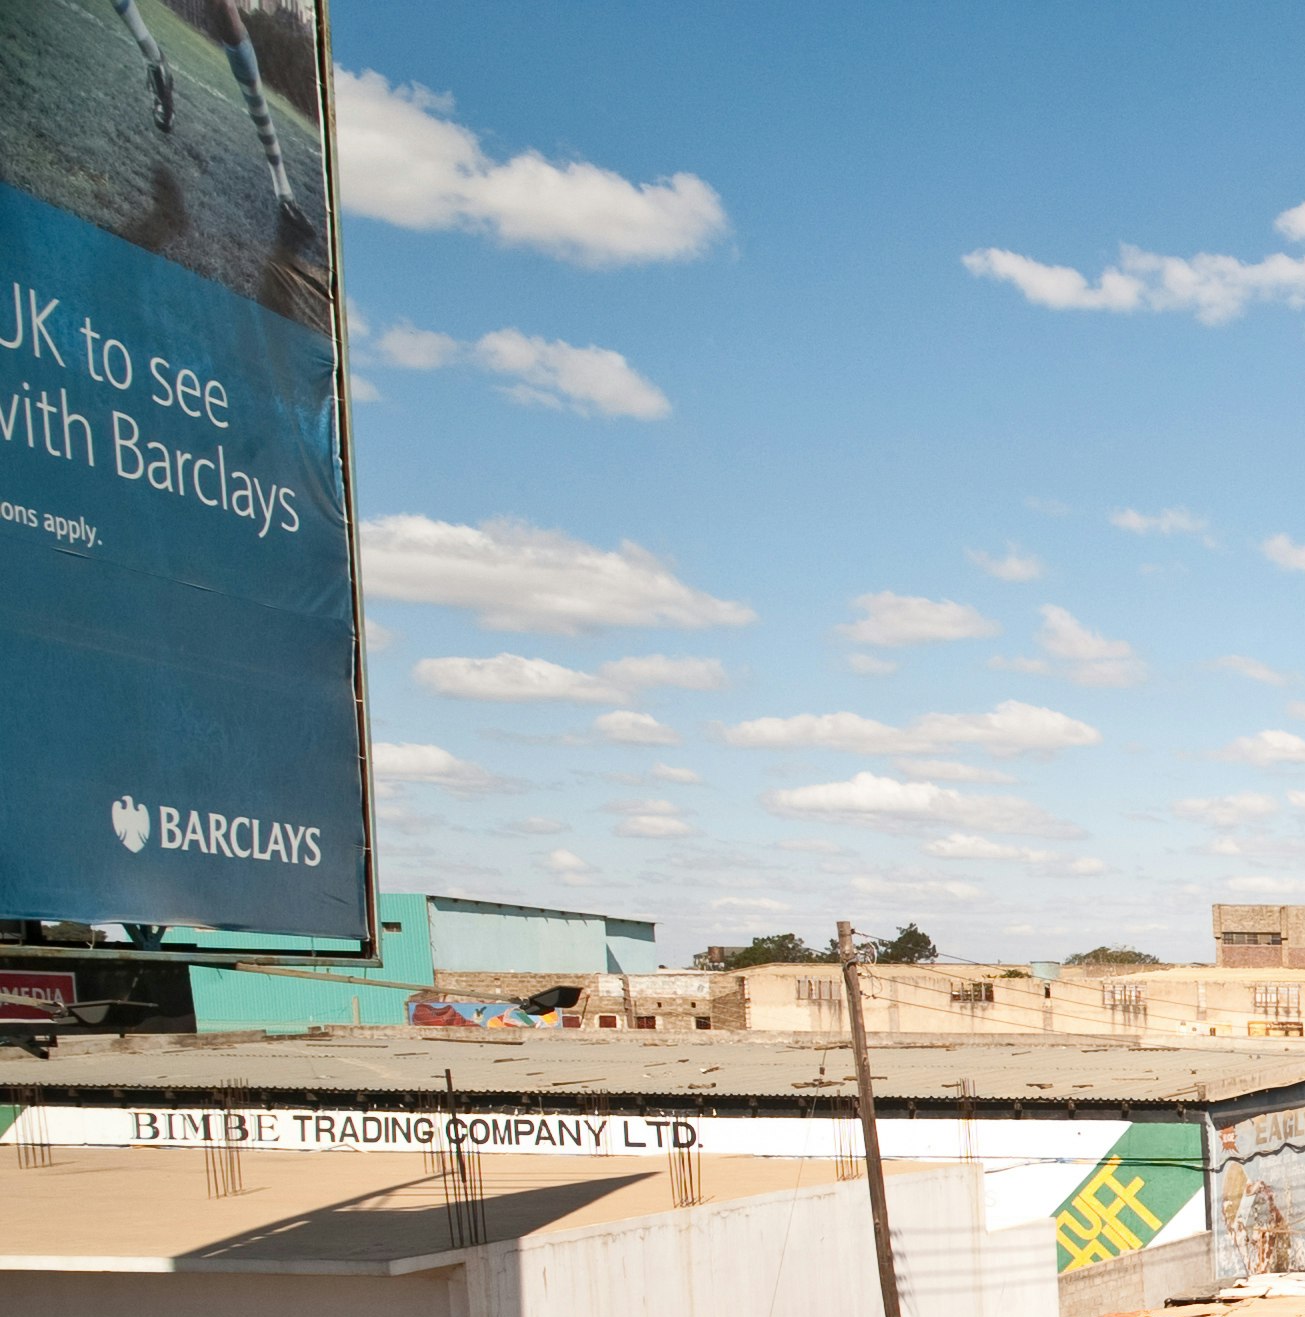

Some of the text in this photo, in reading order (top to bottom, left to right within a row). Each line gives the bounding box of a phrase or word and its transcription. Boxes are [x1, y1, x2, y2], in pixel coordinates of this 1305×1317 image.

[0, 281, 229, 429] UK to see
[112, 410, 300, 538] Barclays
[44, 513, 103, 548] apply.
[159, 804, 323, 867] BARCLAYS
[128, 1111, 704, 1149] BIMBE TRADING COMPANY LTD.
